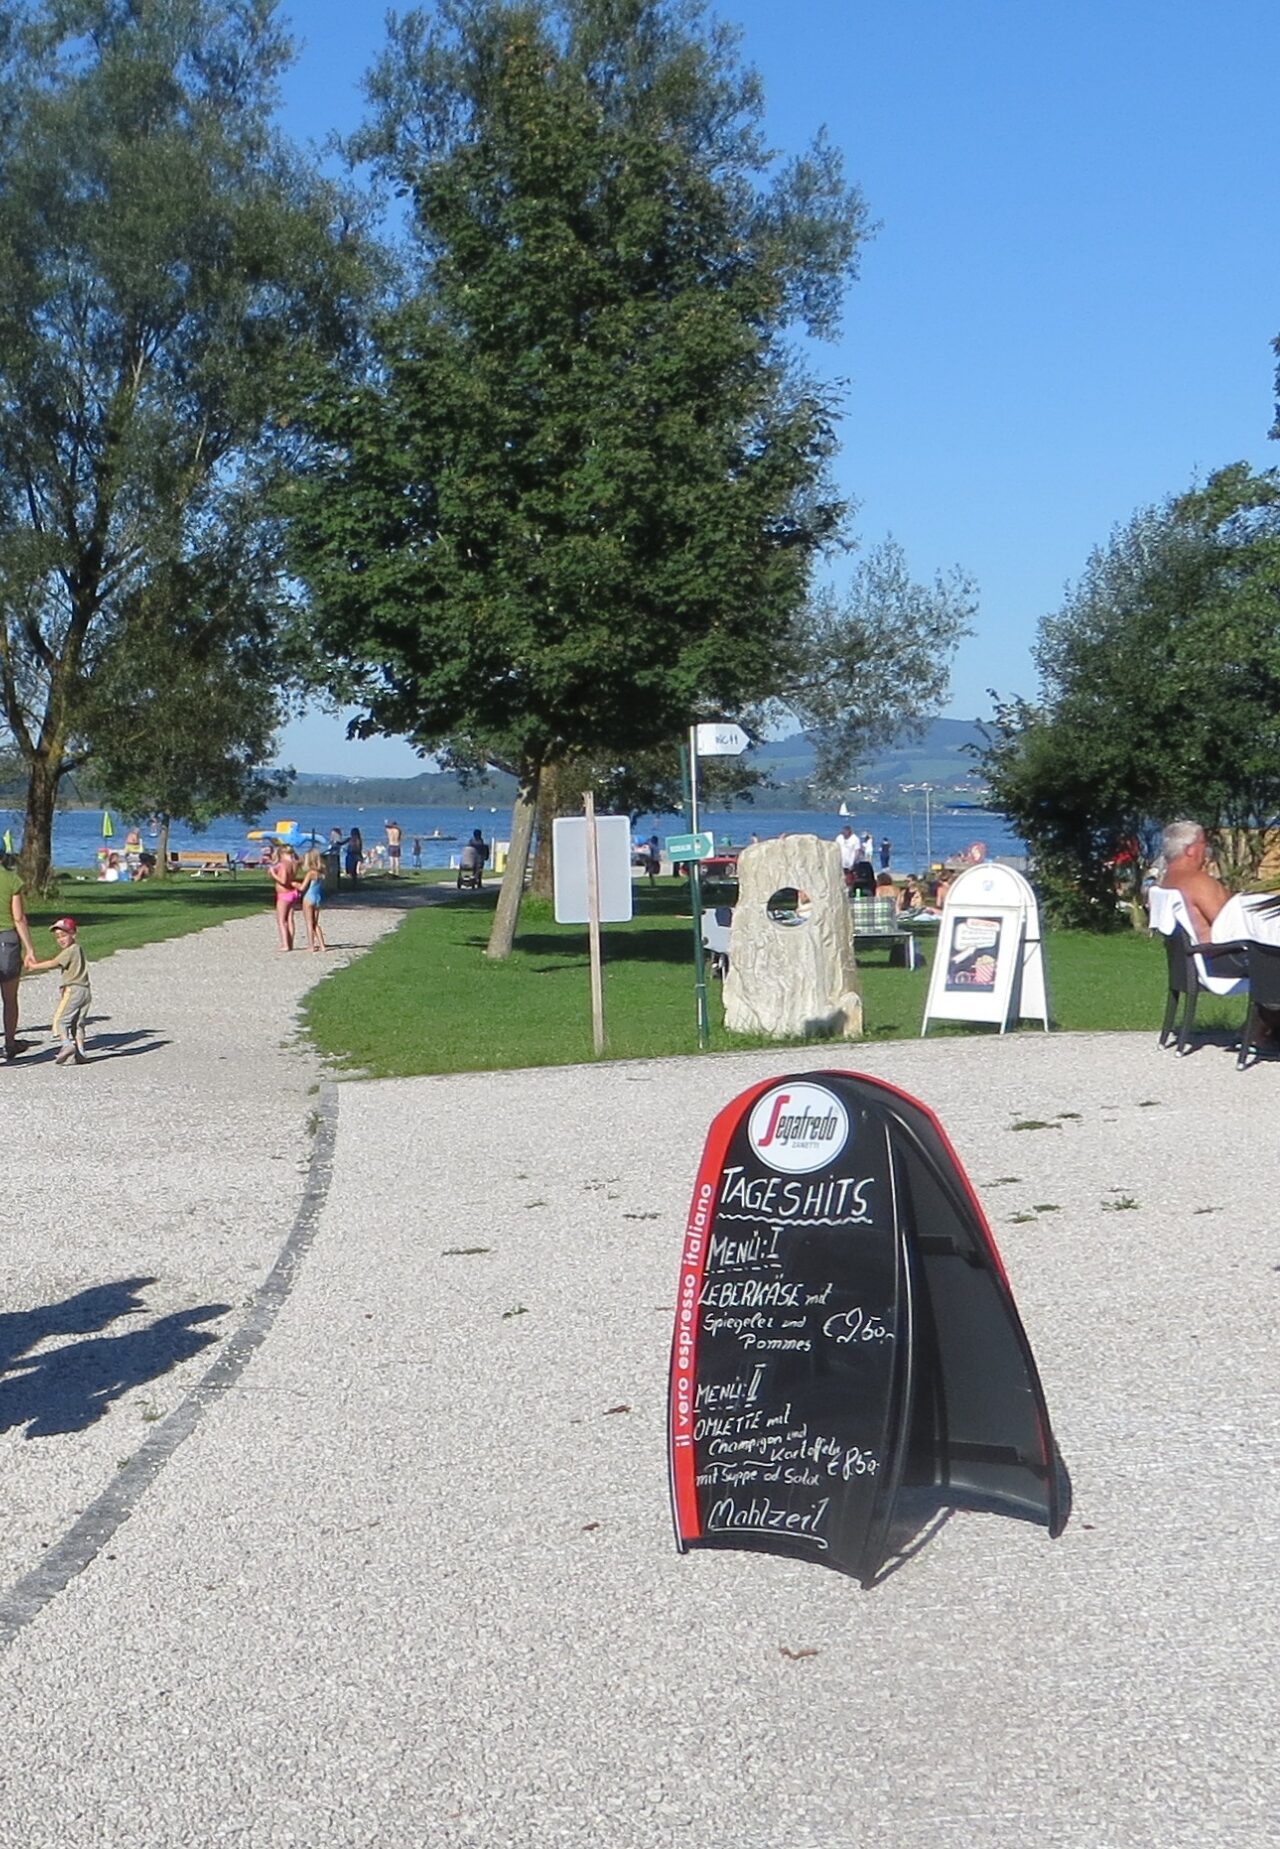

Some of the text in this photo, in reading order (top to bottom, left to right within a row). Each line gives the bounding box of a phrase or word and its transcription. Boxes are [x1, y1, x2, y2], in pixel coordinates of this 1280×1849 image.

[757, 1094, 839, 1147] Segafredo
[697, 1273, 805, 1307] LEBERKÄSE
[676, 1183, 712, 1448] il vero espresso italiano
[738, 1333, 812, 1352] Pommes
[696, 1467, 718, 1486] mit
[721, 1467, 758, 1487] Suppe
